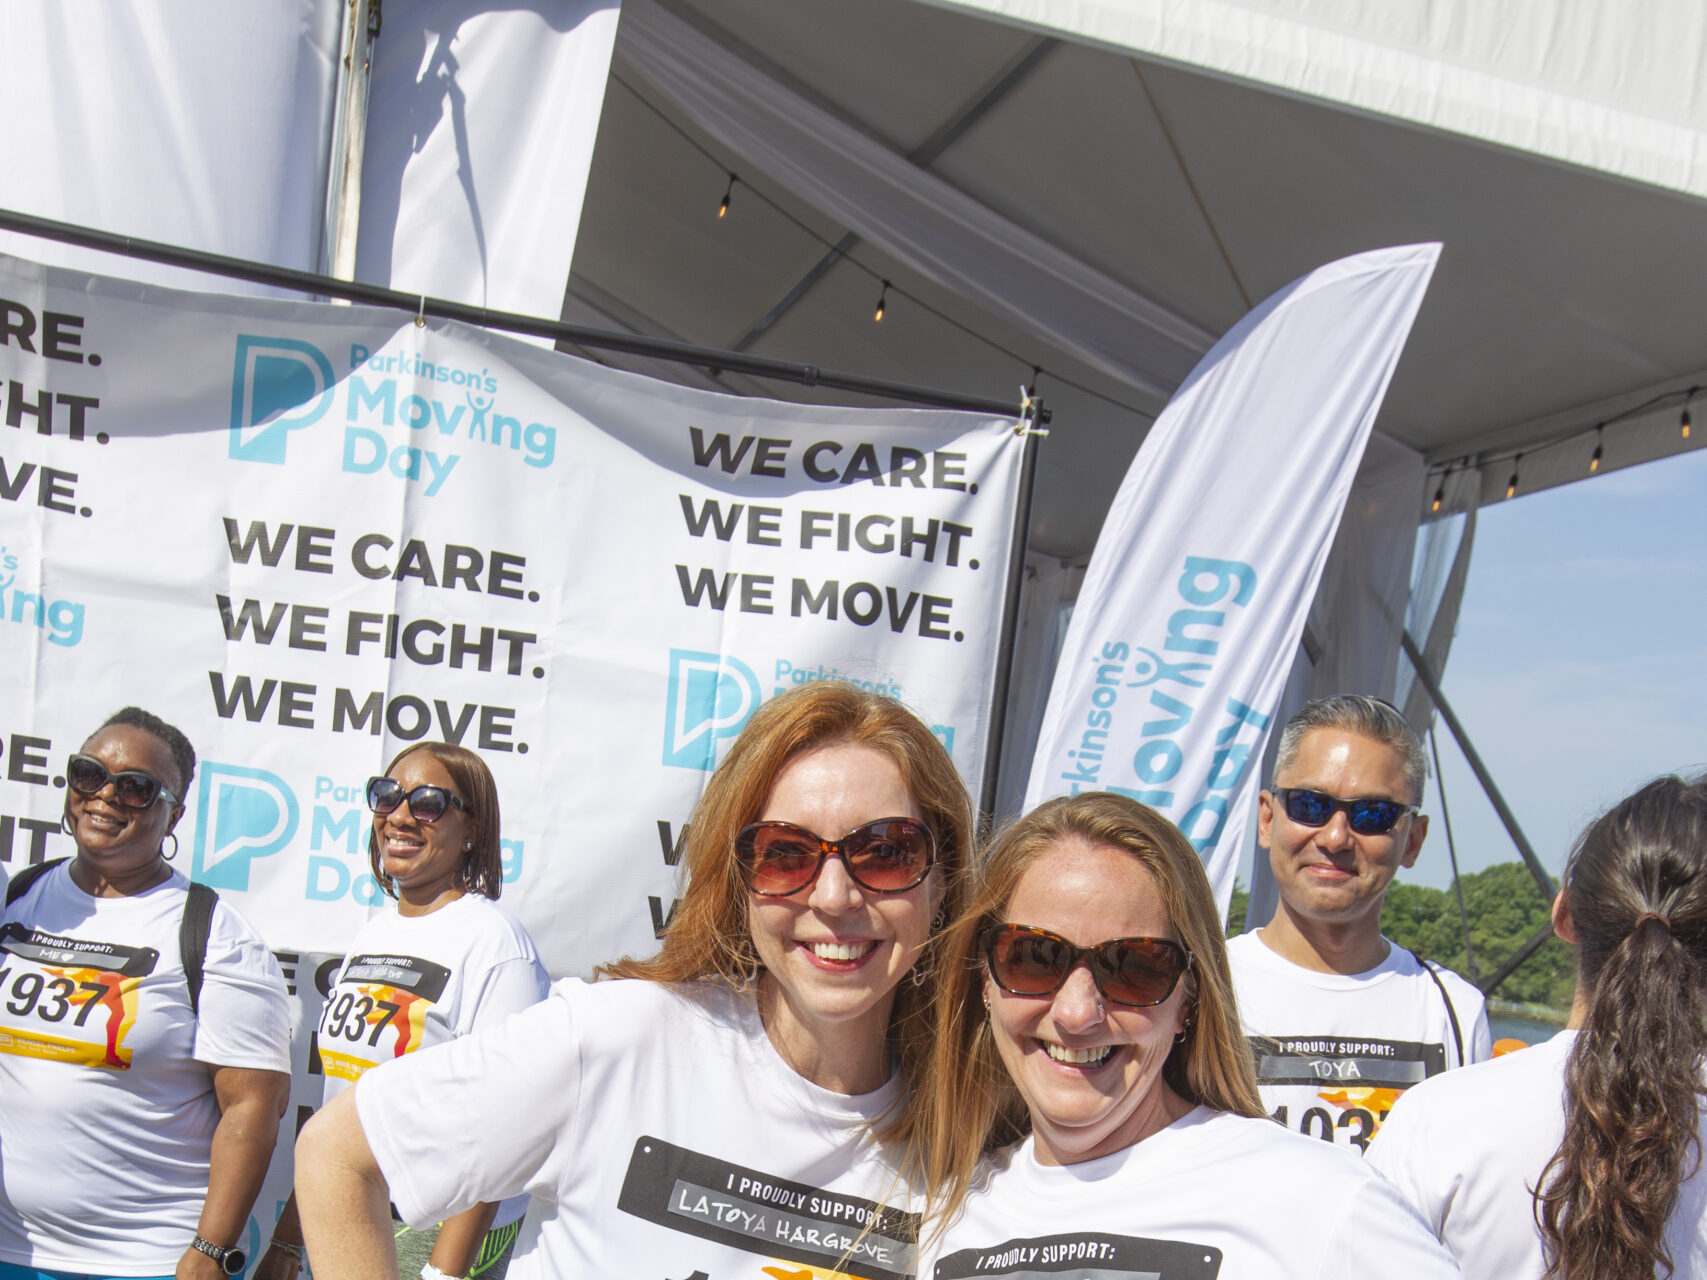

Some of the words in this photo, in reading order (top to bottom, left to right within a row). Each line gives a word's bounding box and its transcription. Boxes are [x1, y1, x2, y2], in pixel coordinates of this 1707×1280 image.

[0, 298, 102, 367] RE.
[350, 343, 498, 394] Parkinson's
[0, 379, 110, 445] HT.
[0, 456, 93, 518] VE.
[341, 426, 461, 498] Day
[689, 426, 792, 478] WE
[802, 440, 979, 495] CARE.
[222, 517, 336, 574] WE
[351, 533, 541, 603] CARE.
[679, 494, 783, 547] WE
[800, 510, 981, 570] FIGHT.
[215, 594, 330, 652] WE
[346, 611, 546, 679] FIGHT.
[675, 564, 774, 615] WE
[790, 577, 965, 642] MOVE.
[208, 671, 317, 729] WE
[332, 687, 529, 754] MOVE.
[1060, 641, 1130, 797] kinson's
[305, 855, 388, 908] Da
[36, 935, 74, 949] PROUDLY
[74, 943, 114, 954] SUPPORT:
[1279, 1042, 1284, 1053] I
[1288, 1042, 1336, 1054] PROUDLY
[1338, 1043, 1395, 1056] SUPPORT:
[1309, 1060, 1361, 1078] TOYA
[678, 1189, 766, 1233] LATOYA
[775, 1219, 893, 1265] HARGROVE
[727, 1173, 735, 1190] I
[739, 1177, 806, 1210] PROUDLY
[810, 1198, 888, 1231] SUPPORT:
[975, 1255, 983, 1270] I
[985, 1246, 1039, 1270] PROUDLY
[1041, 1242, 1116, 1264] SUPPORT:
